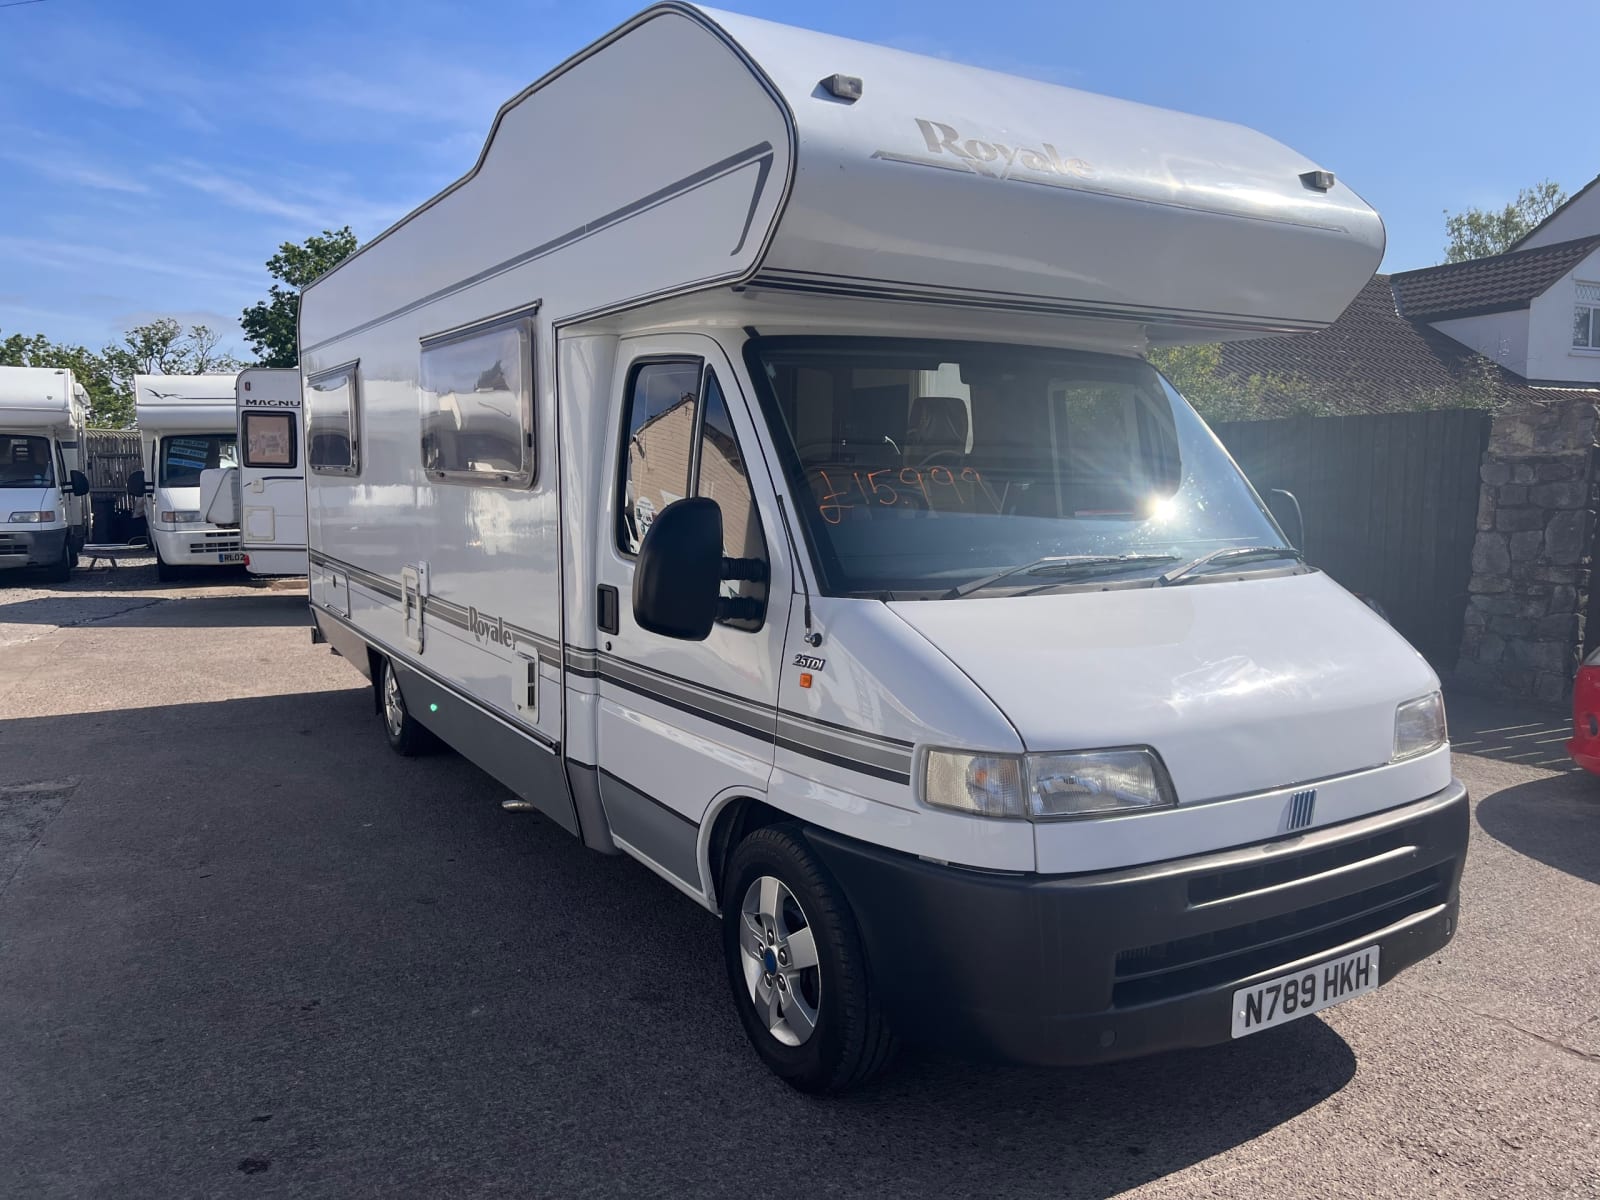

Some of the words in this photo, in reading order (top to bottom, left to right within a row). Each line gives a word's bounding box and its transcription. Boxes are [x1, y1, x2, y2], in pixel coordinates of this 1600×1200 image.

[914, 118, 1099, 181] Royale
[1245, 974, 1317, 1028] N789
[1323, 953, 1370, 1001] HKH
